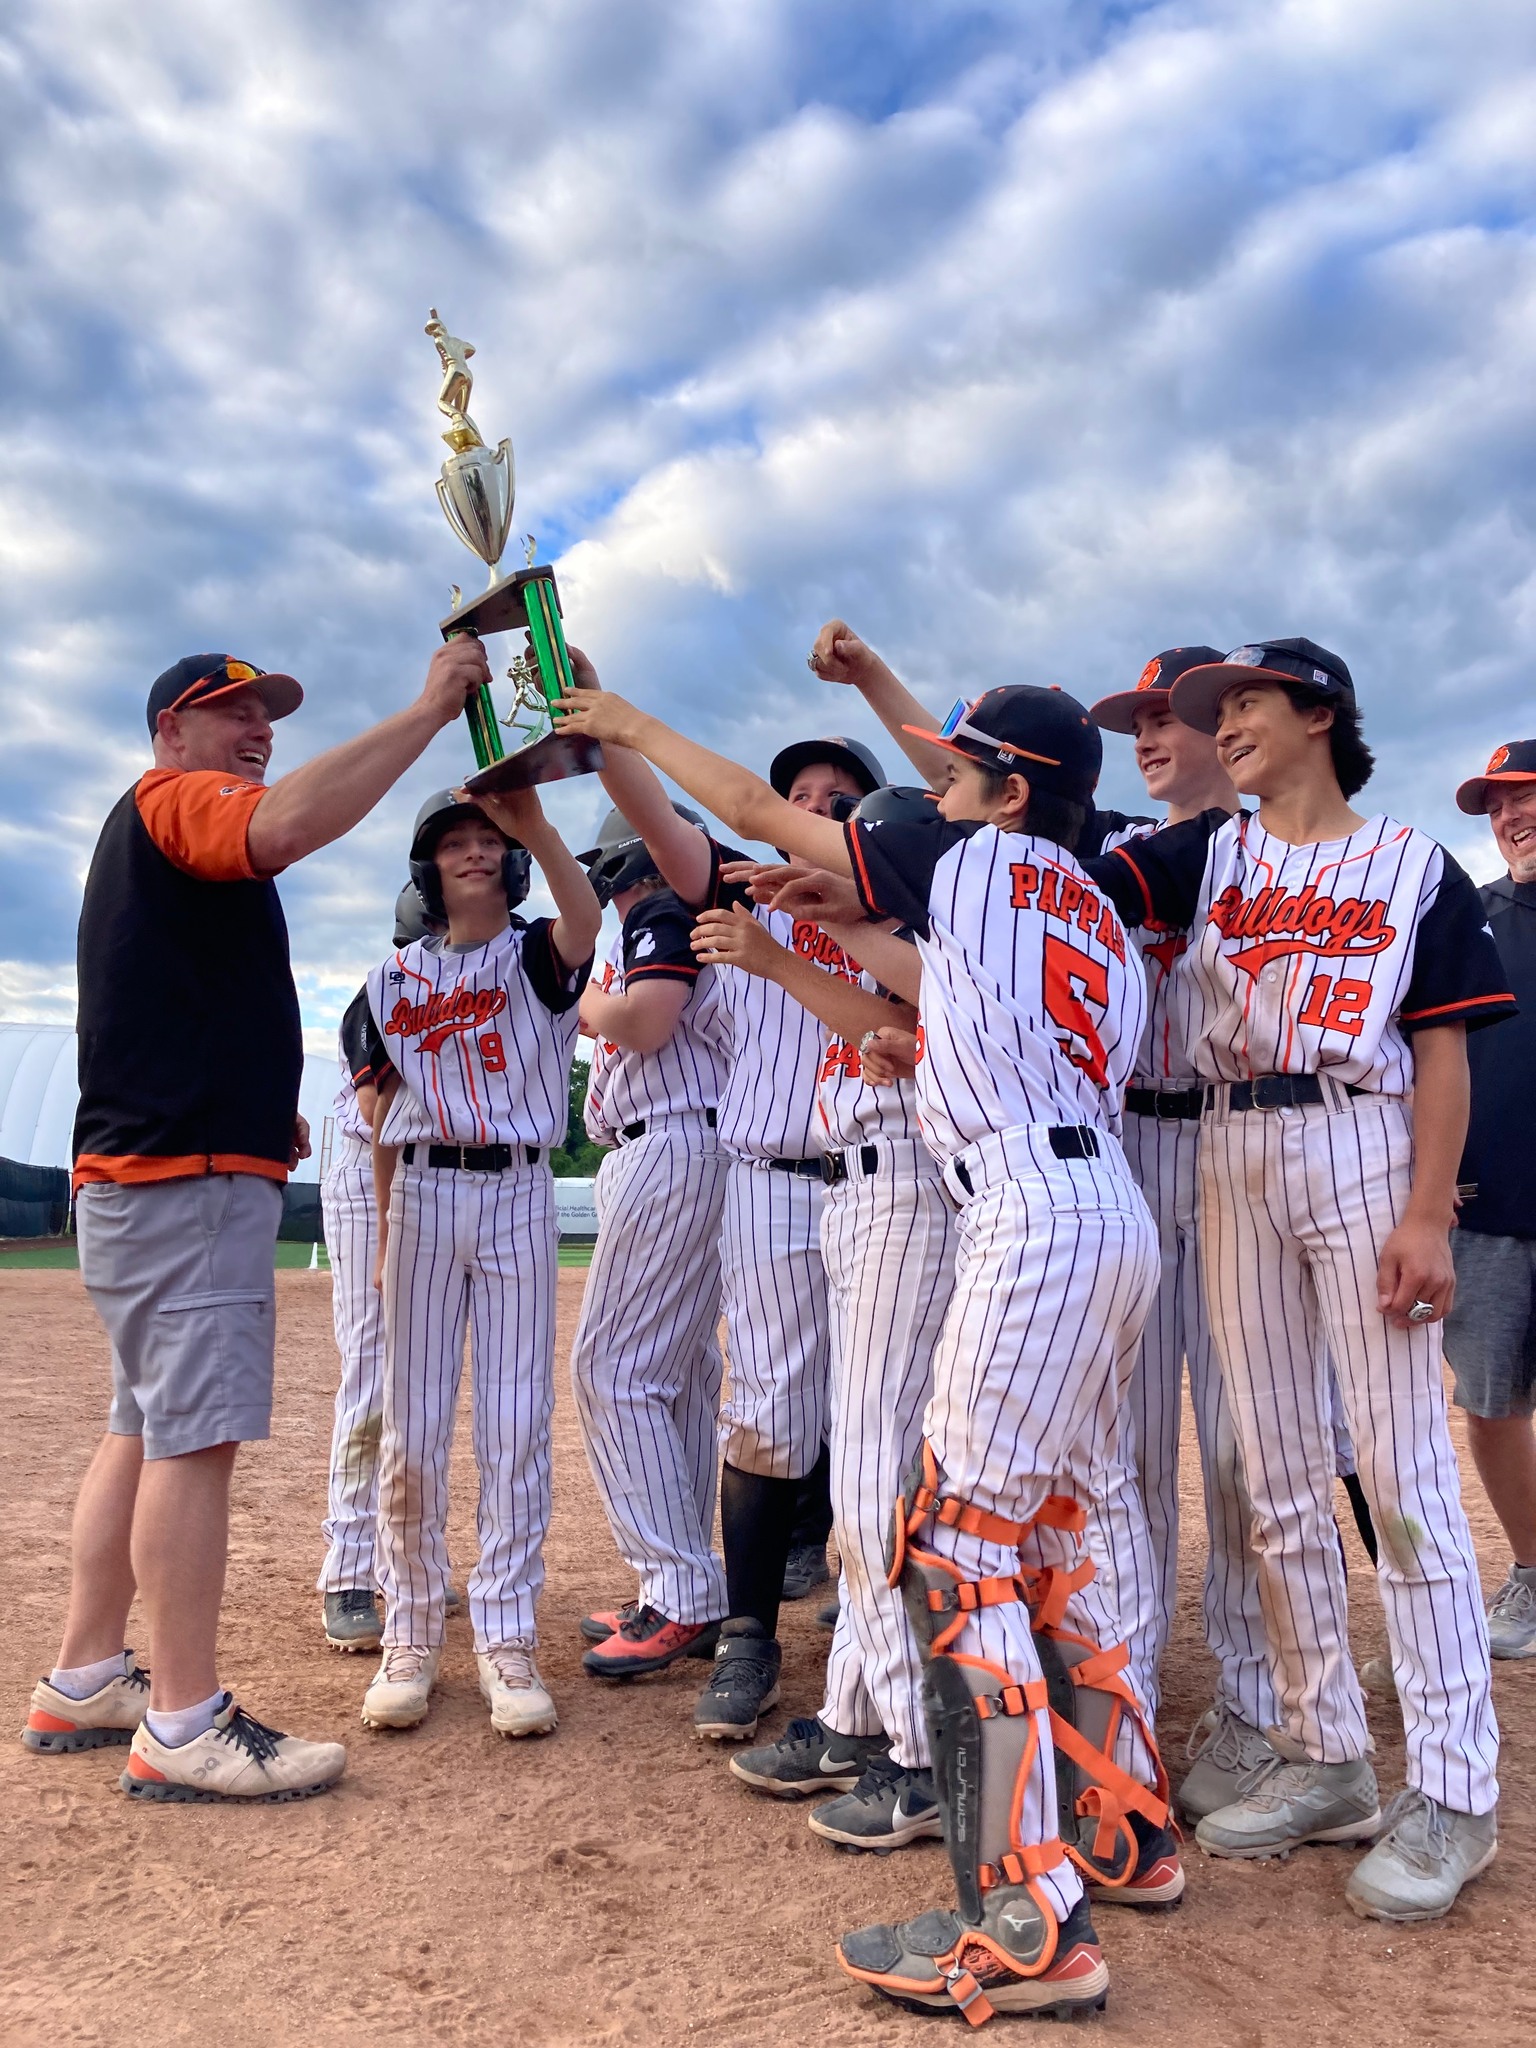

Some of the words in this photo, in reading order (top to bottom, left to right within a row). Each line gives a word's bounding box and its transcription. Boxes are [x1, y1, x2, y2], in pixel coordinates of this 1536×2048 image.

[1206, 884, 1396, 958] Bulldogs
[385, 986, 507, 1039] Bulldogs
[1042, 931, 1110, 1091] 5
[1299, 973, 1374, 1037] 12
[479, 1031, 507, 1073] 9
